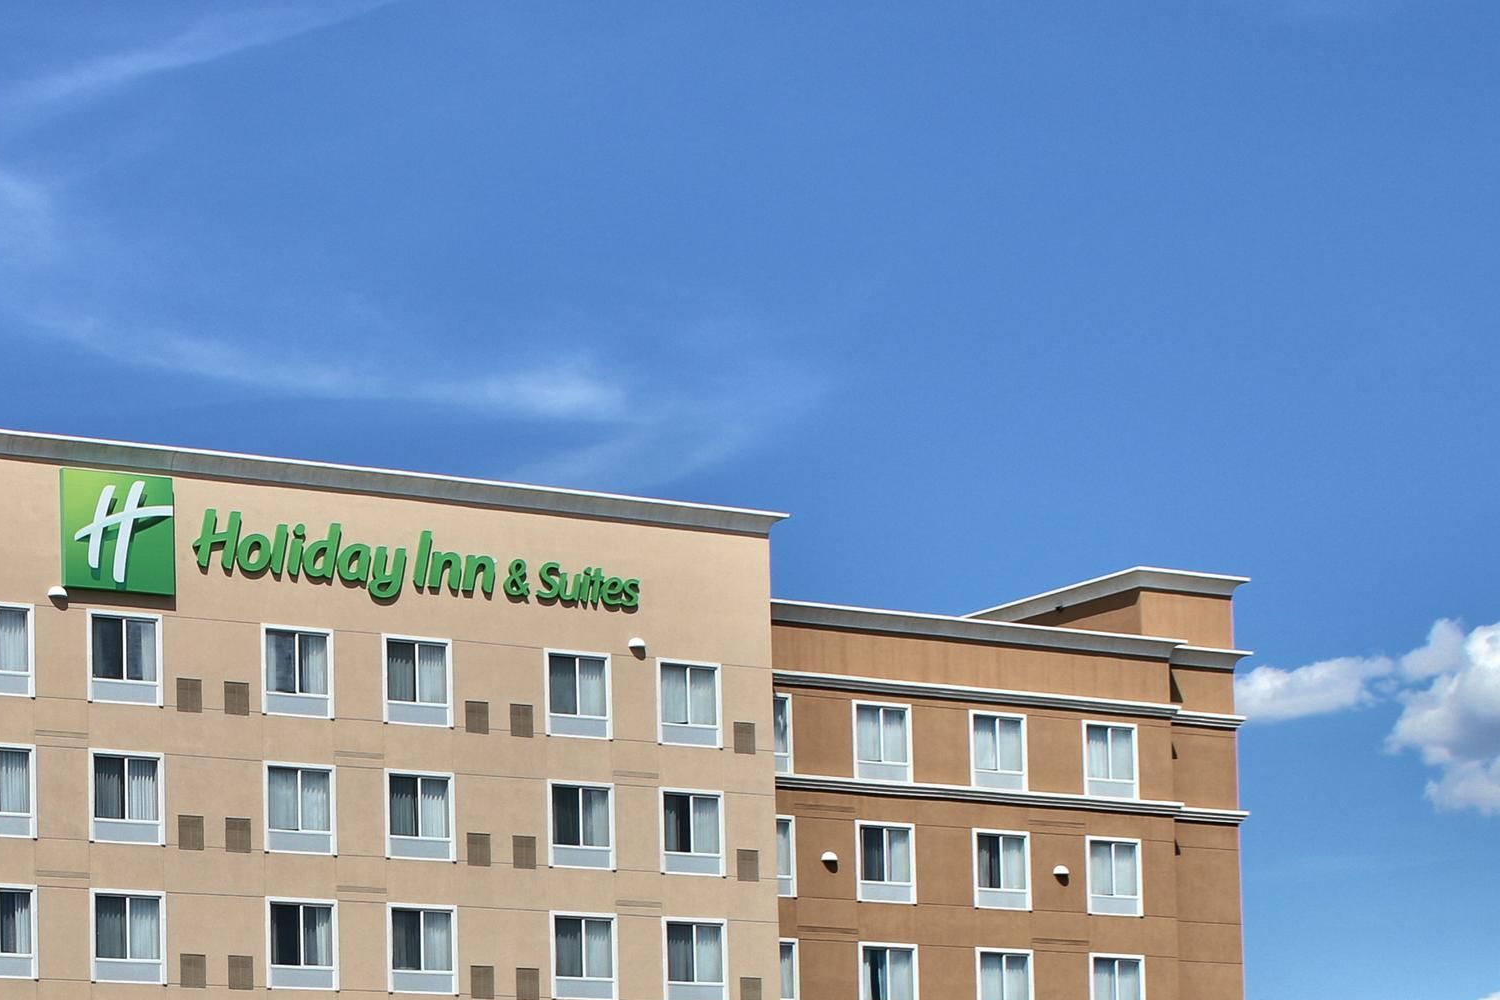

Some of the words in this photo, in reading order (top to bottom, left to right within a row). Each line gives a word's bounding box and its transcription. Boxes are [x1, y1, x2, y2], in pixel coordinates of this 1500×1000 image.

[192, 508, 407, 598] Holiday
[413, 530, 496, 593] Inn
[503, 558, 530, 597] &
[535, 561, 640, 607] Suites
